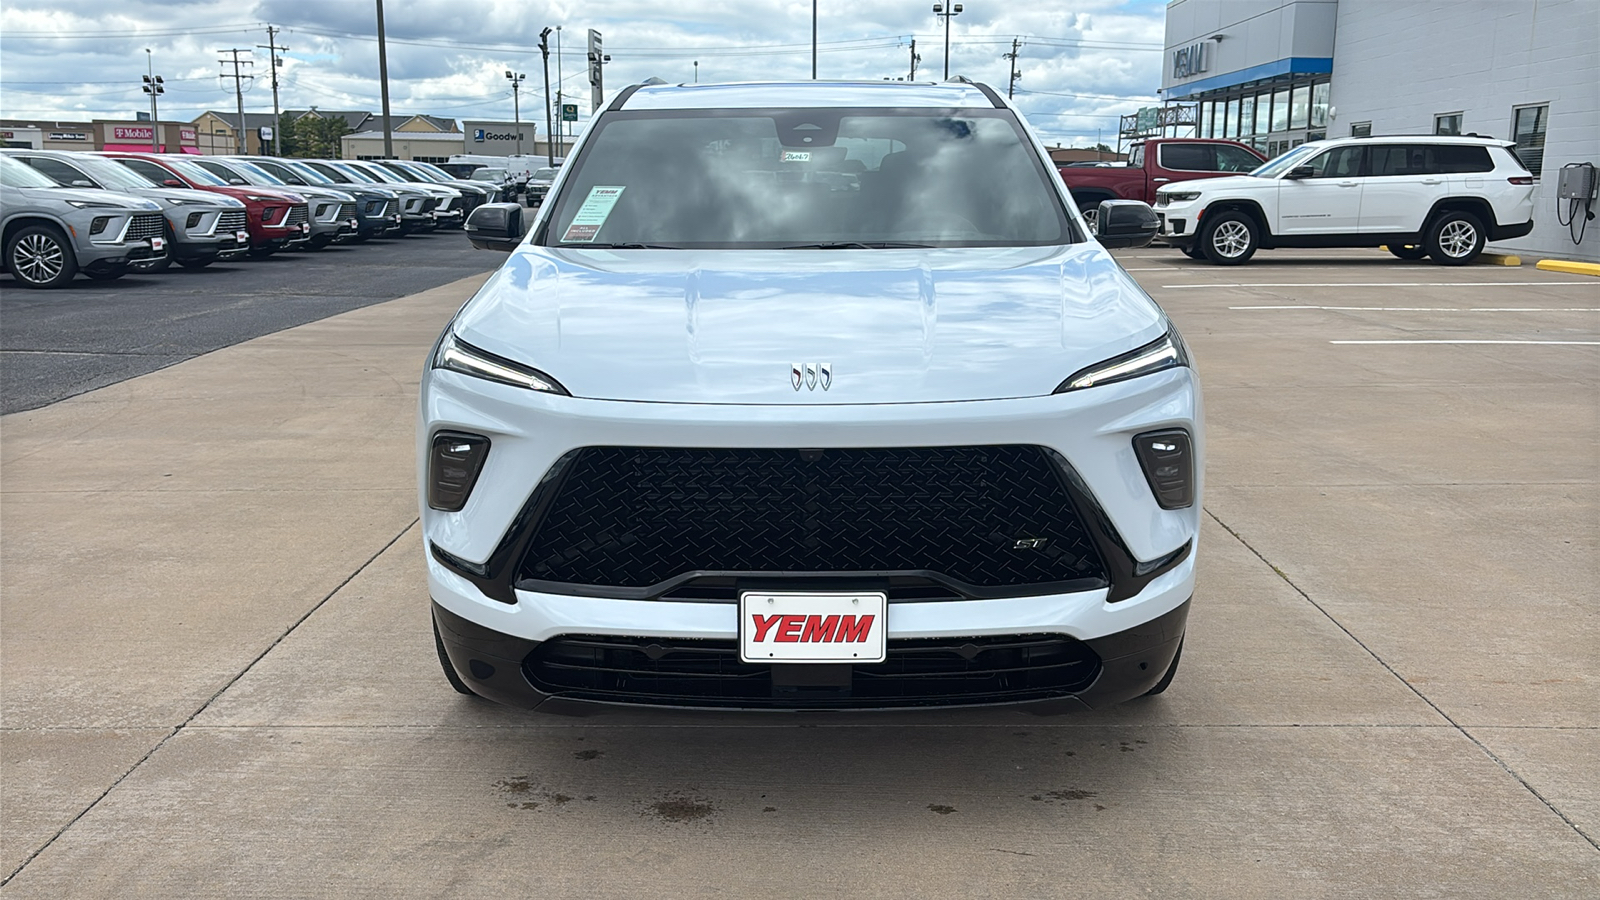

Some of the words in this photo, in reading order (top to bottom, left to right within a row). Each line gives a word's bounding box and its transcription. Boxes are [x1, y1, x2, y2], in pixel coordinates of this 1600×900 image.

[124, 128, 152, 138] Mobile
[485, 132, 524, 141] Goodwll
[1013, 537, 1048, 550] ST
[751, 614, 875, 643] YEMM
